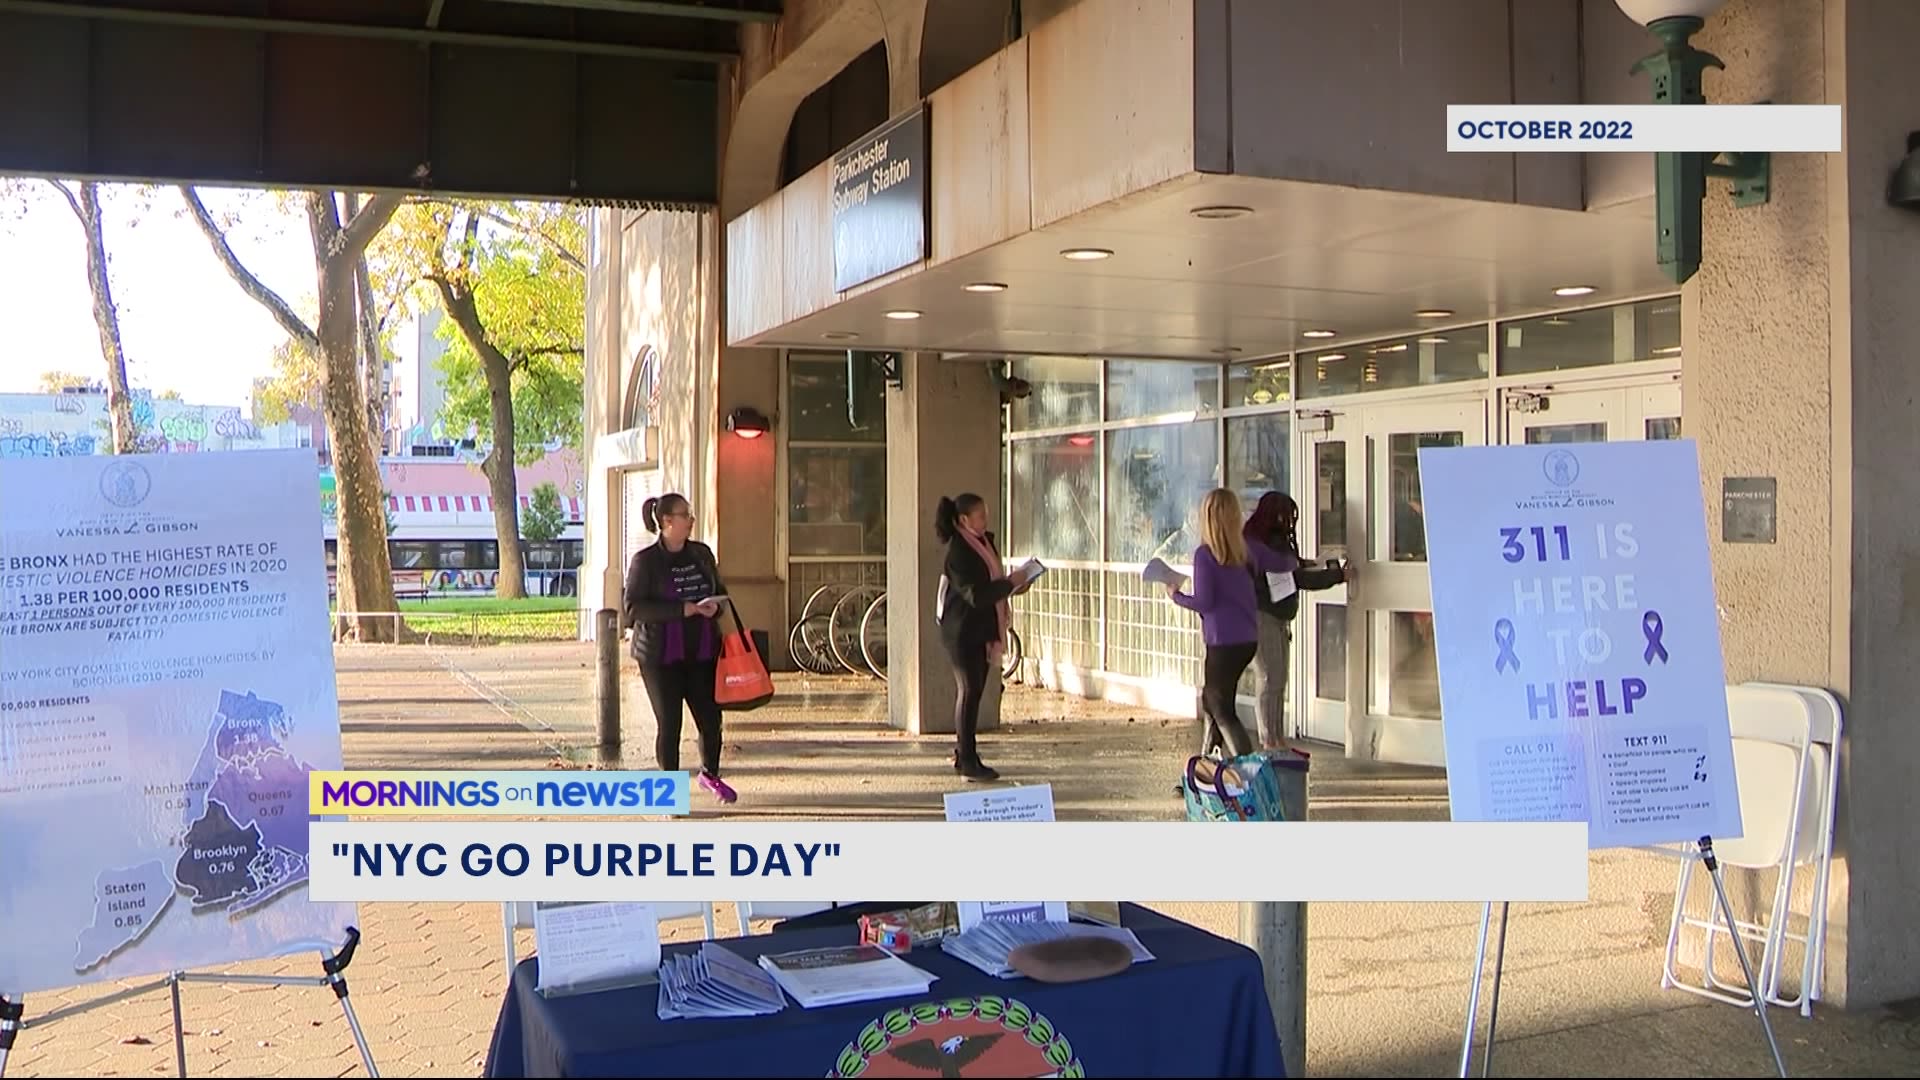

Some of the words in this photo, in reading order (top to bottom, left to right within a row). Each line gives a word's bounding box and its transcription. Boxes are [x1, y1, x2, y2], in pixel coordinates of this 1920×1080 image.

[833, 138, 889, 187] Parkchester
[832, 180, 869, 216] Subway
[872, 157, 910, 195] Station
[1515, 500, 1560, 510] VANESSA
[1576, 498, 1615, 508] GIBSON
[56, 526, 121, 538] VANESSA
[145, 522, 199, 534] GIBSON
[1500, 525, 1570, 563] 311
[1596, 523, 1640, 560] IS
[10, 554, 69, 570] BRONX
[73, 552, 107, 567] HAD
[111, 550, 142, 564] THE
[146, 545, 212, 562] HIGHEST
[216, 543, 254, 558] RATE
[258, 542, 278, 556] OF
[56, 567, 136, 585] VIOLENCE
[139, 561, 227, 580] HOMICIDES
[231, 561, 246, 575] IN
[251, 558, 288, 574] 2020
[20, 593, 54, 608] 1.38
[58, 590, 89, 605] PER
[93, 586, 160, 603] 100,000
[164, 580, 249, 599] RESIDENTS
[1512, 574, 1639, 616] HERE
[40, 606, 96, 620] PERSONS
[97, 605, 122, 616] OUT
[124, 603, 138, 614] OF
[141, 600, 176, 613] EVERY
[179, 597, 225, 610] 100,000
[228, 592, 287, 606] RESIDENTS
[20, 622, 64, 634] BRONX
[64, 619, 87, 632] ARE
[89, 616, 141, 630] SUBJECT
[144, 615, 159, 627] TO
[160, 614, 169, 625] A
[171, 610, 230, 624] DOMESTIC
[231, 606, 285, 620] VIOLENCE
[108, 629, 164, 642] FATALITY)
[1547, 627, 1611, 665] TO
[21, 667, 52, 680] YORK
[54, 665, 80, 678] CITY
[82, 661, 140, 675] DOMESTIC
[141, 656, 194, 670] VIOLENCE
[73, 674, 129, 689] BOROUGH
[39, 695, 91, 708] RESIDENTS
[1525, 677, 1648, 721] HELP
[227, 717, 263, 730] Bronx
[234, 732, 259, 746] 1.38
[1624, 736, 1648, 747] TEXT
[1652, 735, 1667, 745] 911
[1505, 744, 1533, 755] CALL
[1537, 743, 1554, 753] 911
[144, 781, 209, 796] Manhattan
[247, 789, 293, 804] Queens
[193, 844, 248, 861] Brooklyn
[208, 861, 235, 874] 0.76
[104, 881, 146, 896] Staten
[108, 897, 146, 912] Island
[114, 915, 142, 928] 0.85
